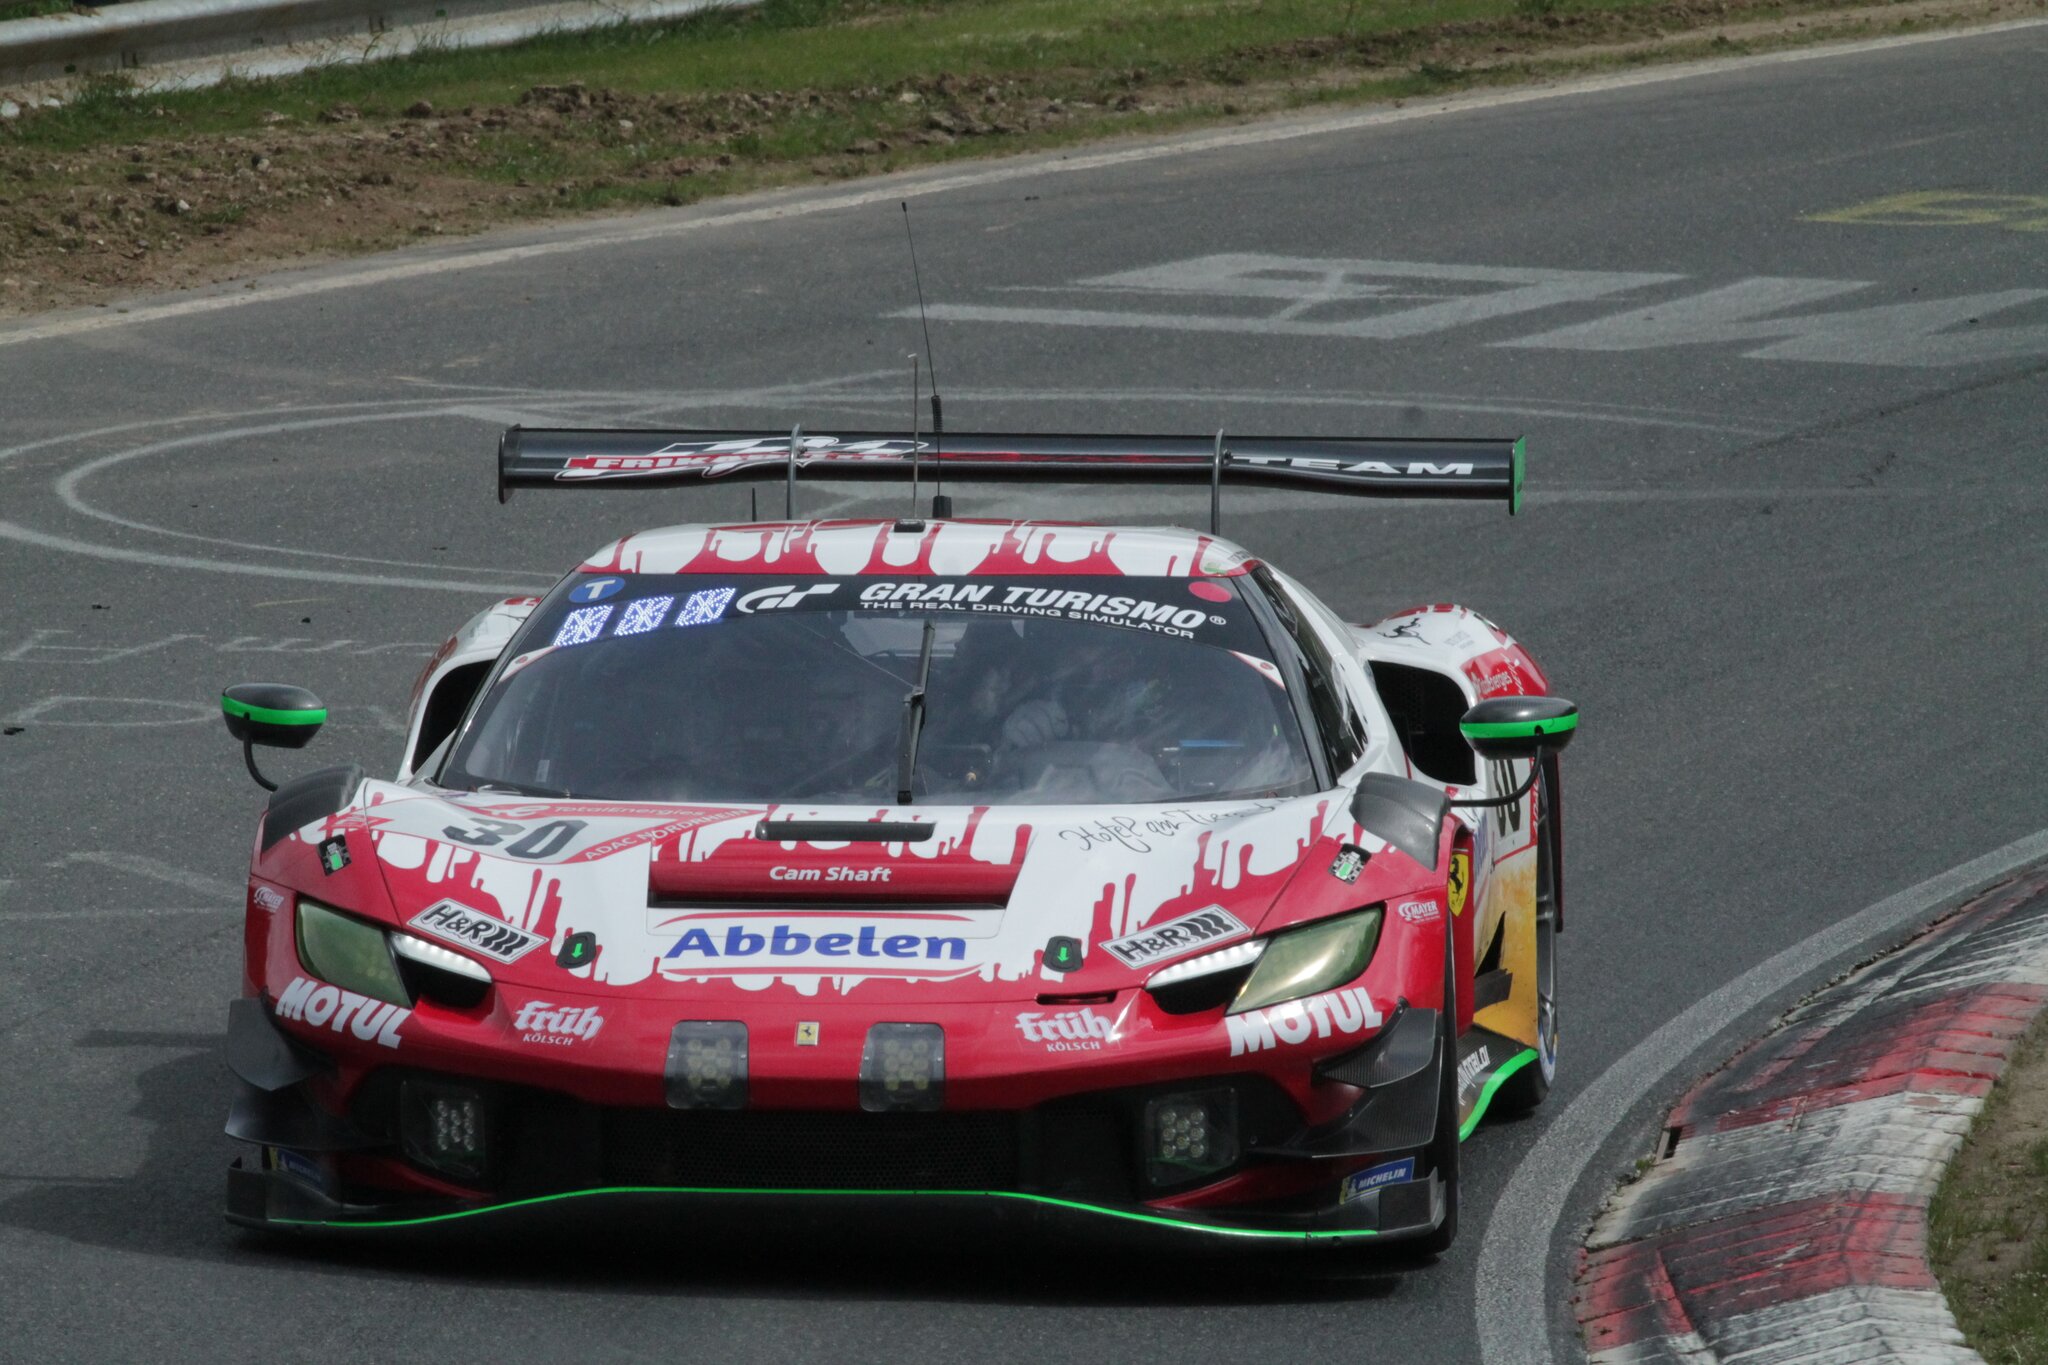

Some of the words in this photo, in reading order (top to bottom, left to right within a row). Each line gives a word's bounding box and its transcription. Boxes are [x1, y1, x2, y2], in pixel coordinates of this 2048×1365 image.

[1233, 456, 1473, 474] TEAM
[859, 583, 994, 602] GRAN
[910, 602, 966, 610] REAL
[972, 604, 1061, 617] DRIVING
[1068, 611, 1194, 639] SIMULATOR
[554, 805, 705, 817] TotalEnergies
[442, 818, 588, 859] 30
[585, 836, 637, 860] ADAC
[637, 808, 750, 841] NORDRHEIN
[769, 866, 821, 881] Cam
[825, 866, 892, 882] Shaft
[423, 904, 494, 940] H&R
[664, 925, 967, 960] Abbelen
[1113, 928, 1191, 960] H&R
[275, 976, 412, 1049] MOTUL
[1225, 986, 1383, 1057] MOTUL
[522, 1033, 574, 1046] KÖLSCH
[1046, 1041, 1101, 1052] KÖLSCH
[1357, 1167, 1407, 1189] MICHELIN
